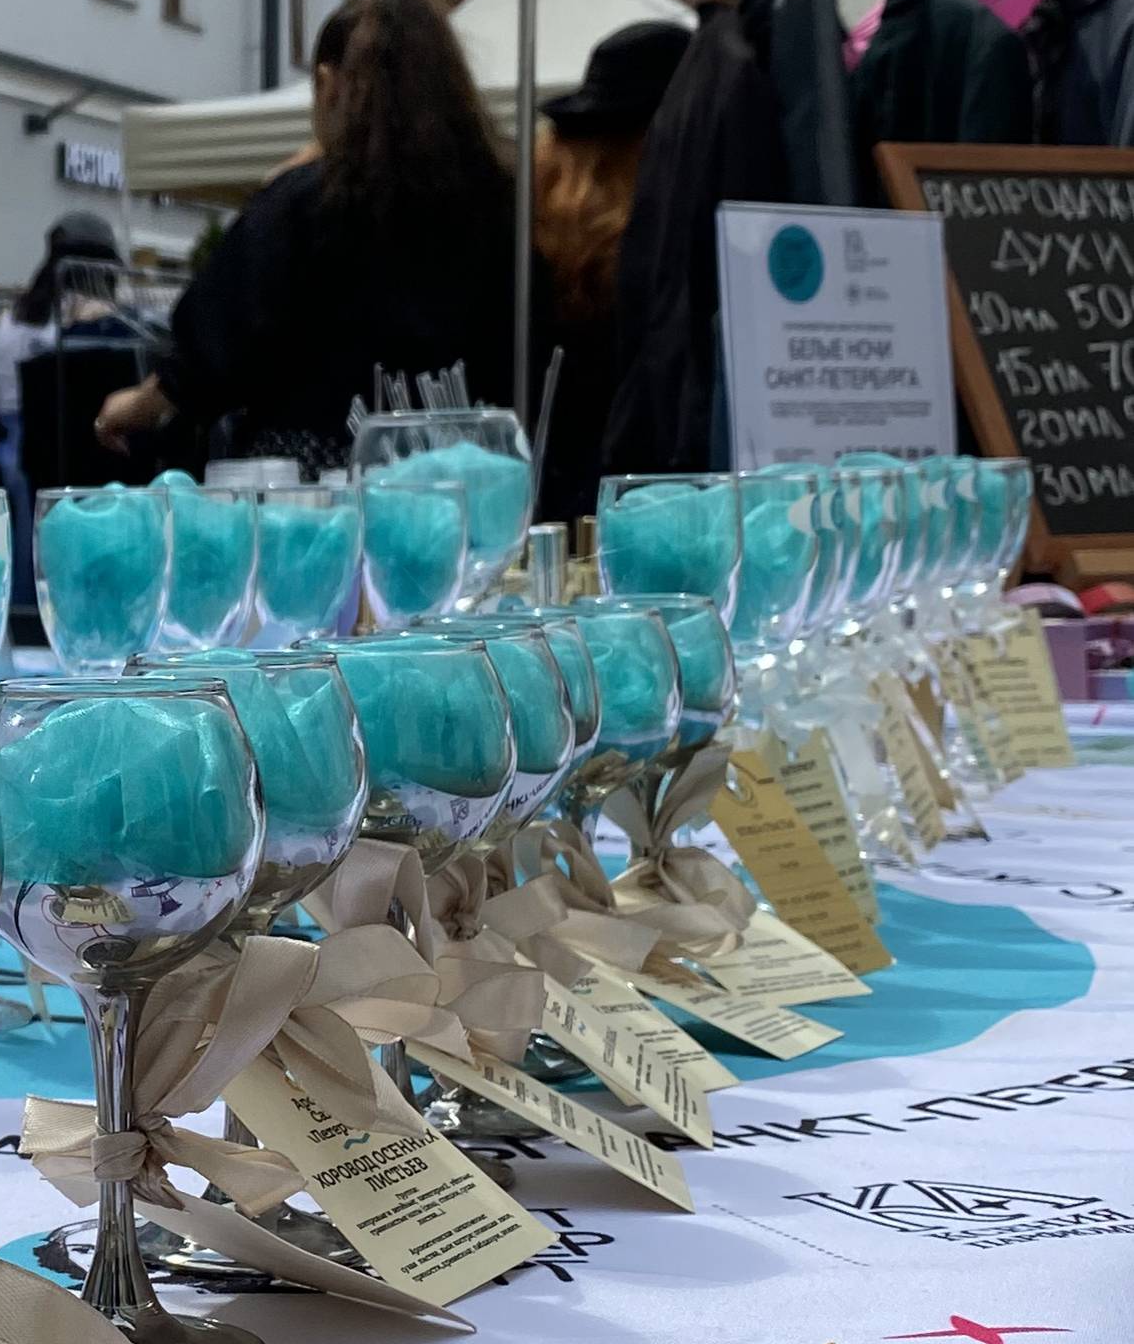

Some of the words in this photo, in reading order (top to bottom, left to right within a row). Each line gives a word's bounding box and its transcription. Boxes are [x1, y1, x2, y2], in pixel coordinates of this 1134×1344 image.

[922, 178, 1134, 222] РАСПРОДАЖ
[990, 225, 1134, 276] ДУХИ
[1065, 282, 1134, 330] 50
[848, 336, 892, 362] НОЧИ
[645, 1058, 1134, 1151] АНКТ-ПЕТЕР
[311, 1154, 381, 1190] ХОРОВОД
[363, 1156, 429, 1193] ЛИСТЬЕВ
[922, 1208, 1134, 1242] КСЕНИЯ
